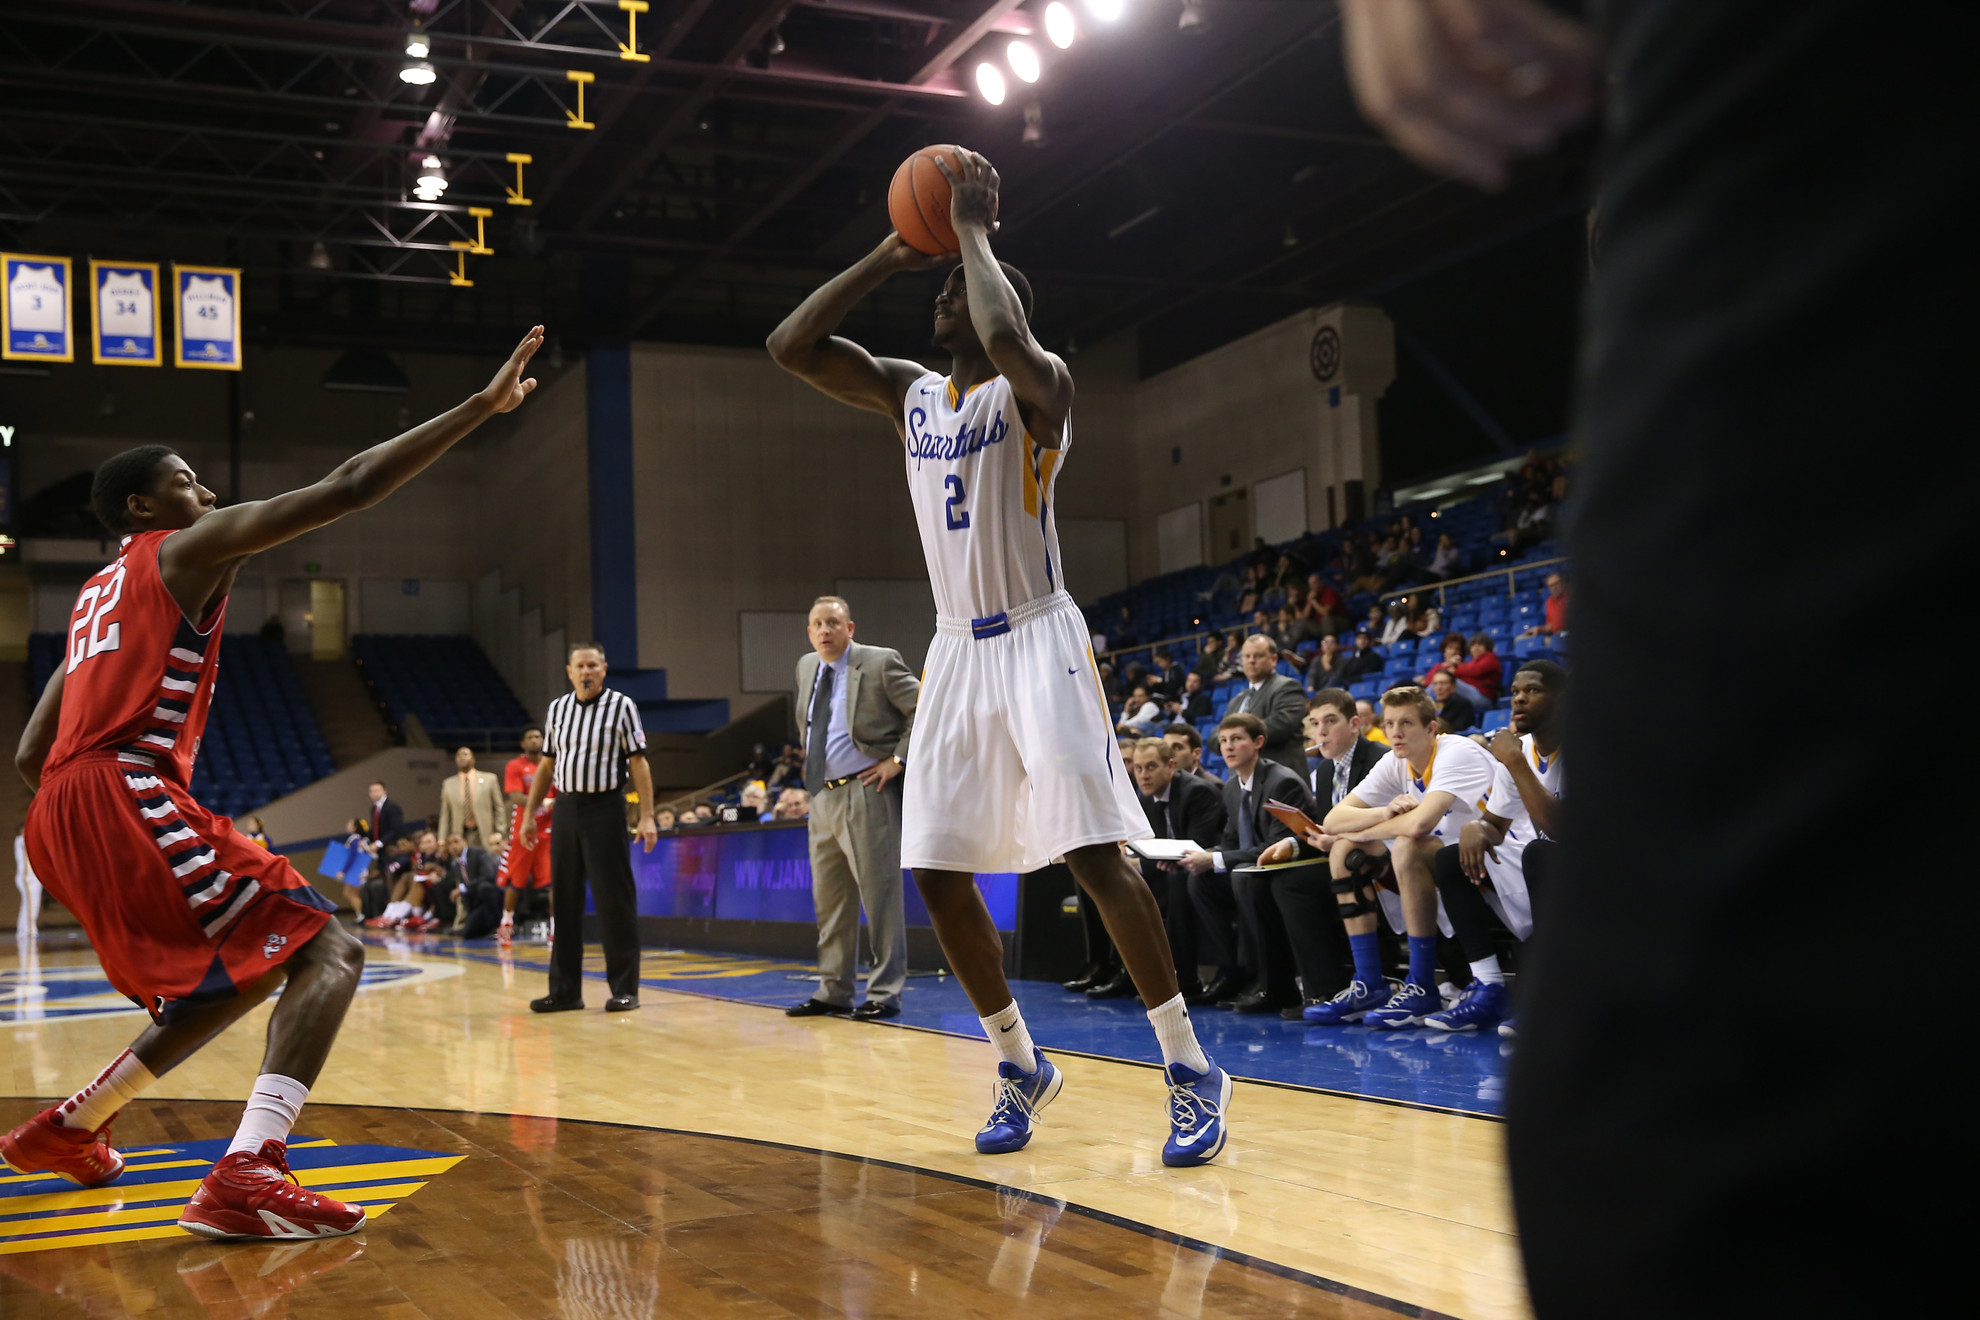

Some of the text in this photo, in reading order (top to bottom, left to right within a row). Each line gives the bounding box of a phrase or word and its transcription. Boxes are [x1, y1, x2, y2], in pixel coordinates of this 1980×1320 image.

[32, 295, 43, 311] 3
[115, 300, 137, 316] 34
[197, 305, 219, 321] 45
[944, 474, 971, 531] 2
[65, 564, 127, 676] 22
